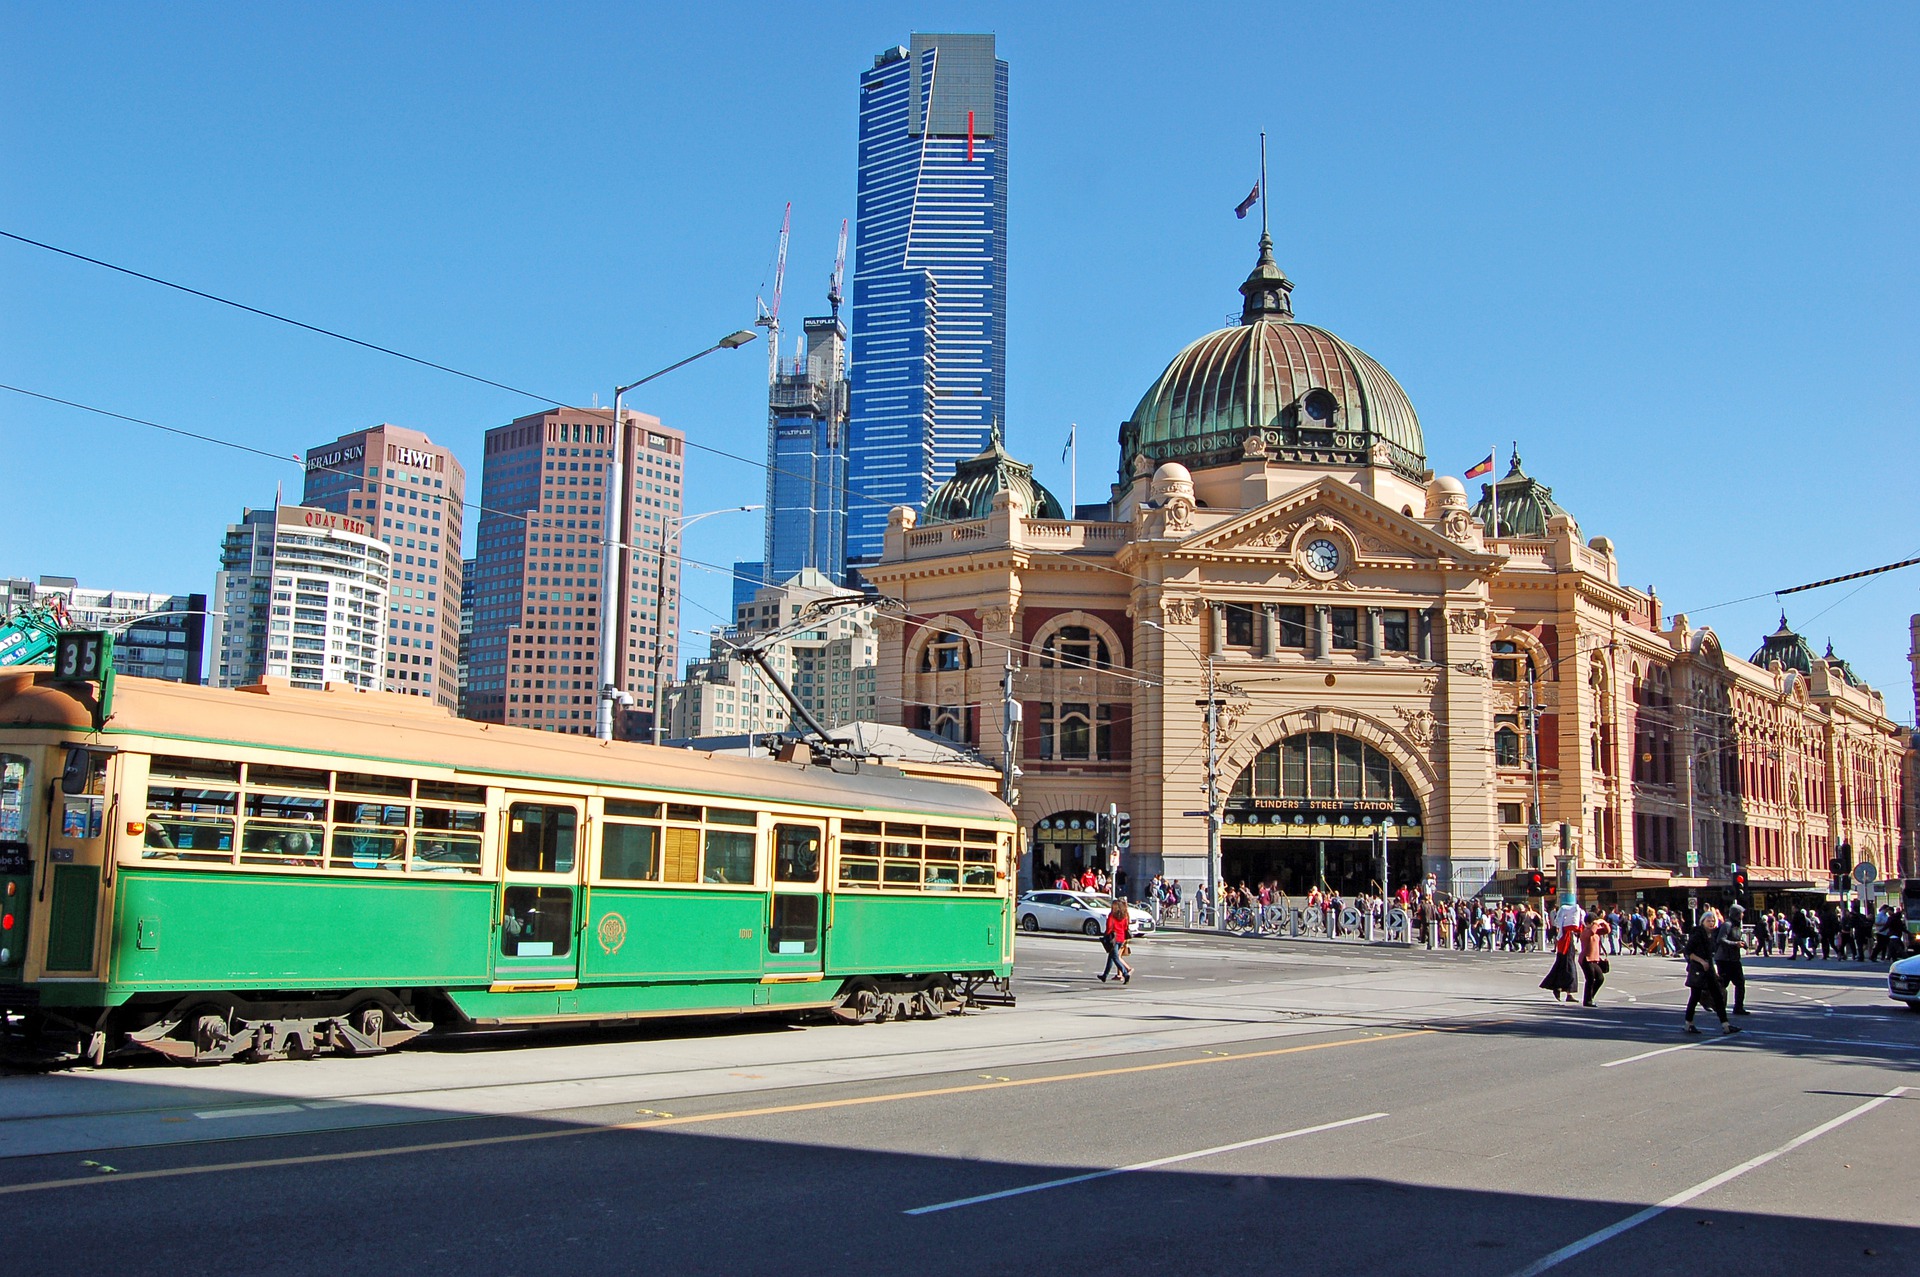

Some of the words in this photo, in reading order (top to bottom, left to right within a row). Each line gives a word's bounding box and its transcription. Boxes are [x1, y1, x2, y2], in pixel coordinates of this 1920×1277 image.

[650, 434, 665, 446] IBM
[307, 452, 341, 471] HERALD
[343, 444, 364, 461] SUN
[399, 447, 435, 468] HWT
[305, 512, 337, 528] QUAY
[342, 517, 365, 535] WEST
[64, 641, 97, 675] 35
[1255, 800, 1299, 809] FLINDERS
[1310, 801, 1343, 810] STREET
[1353, 801, 1394, 810] STATION
